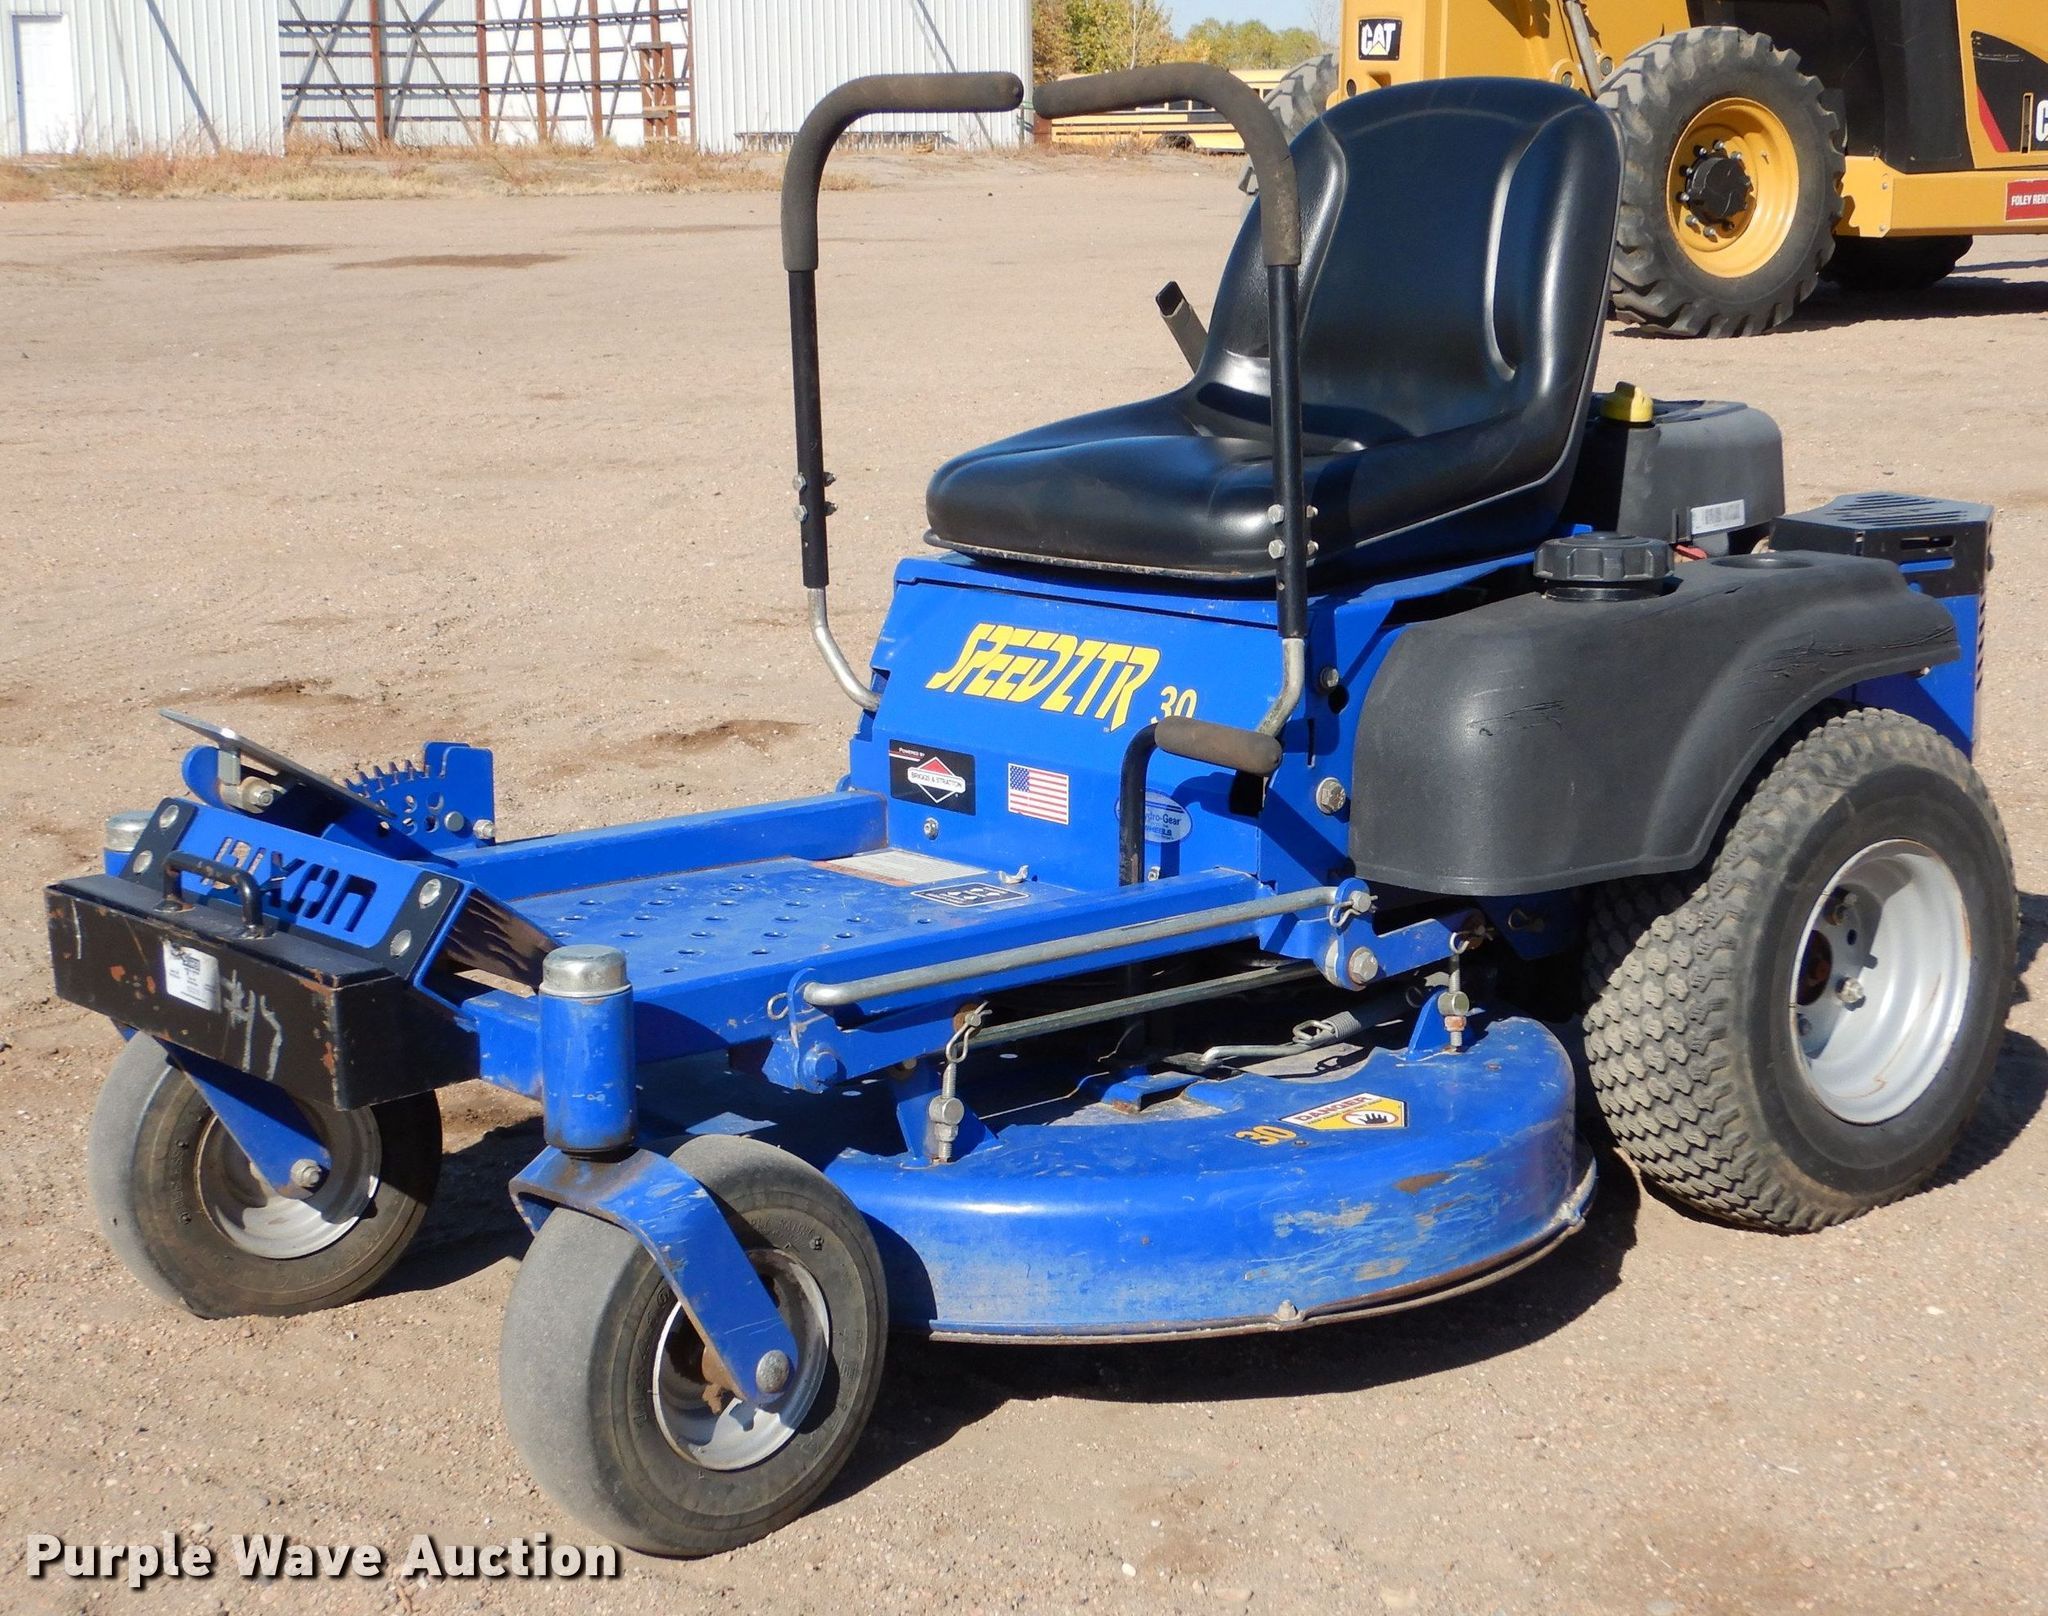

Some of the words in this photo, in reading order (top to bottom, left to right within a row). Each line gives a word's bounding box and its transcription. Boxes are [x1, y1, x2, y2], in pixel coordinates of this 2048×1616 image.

[1361, 22, 1396, 56] CAT
[2011, 195, 2032, 206] FOLEY
[1150, 685, 1197, 724] 30
[201, 836, 378, 933] DIXON
[1294, 1096, 1373, 1121] DANGER
[1235, 1125, 1297, 1146] 30
